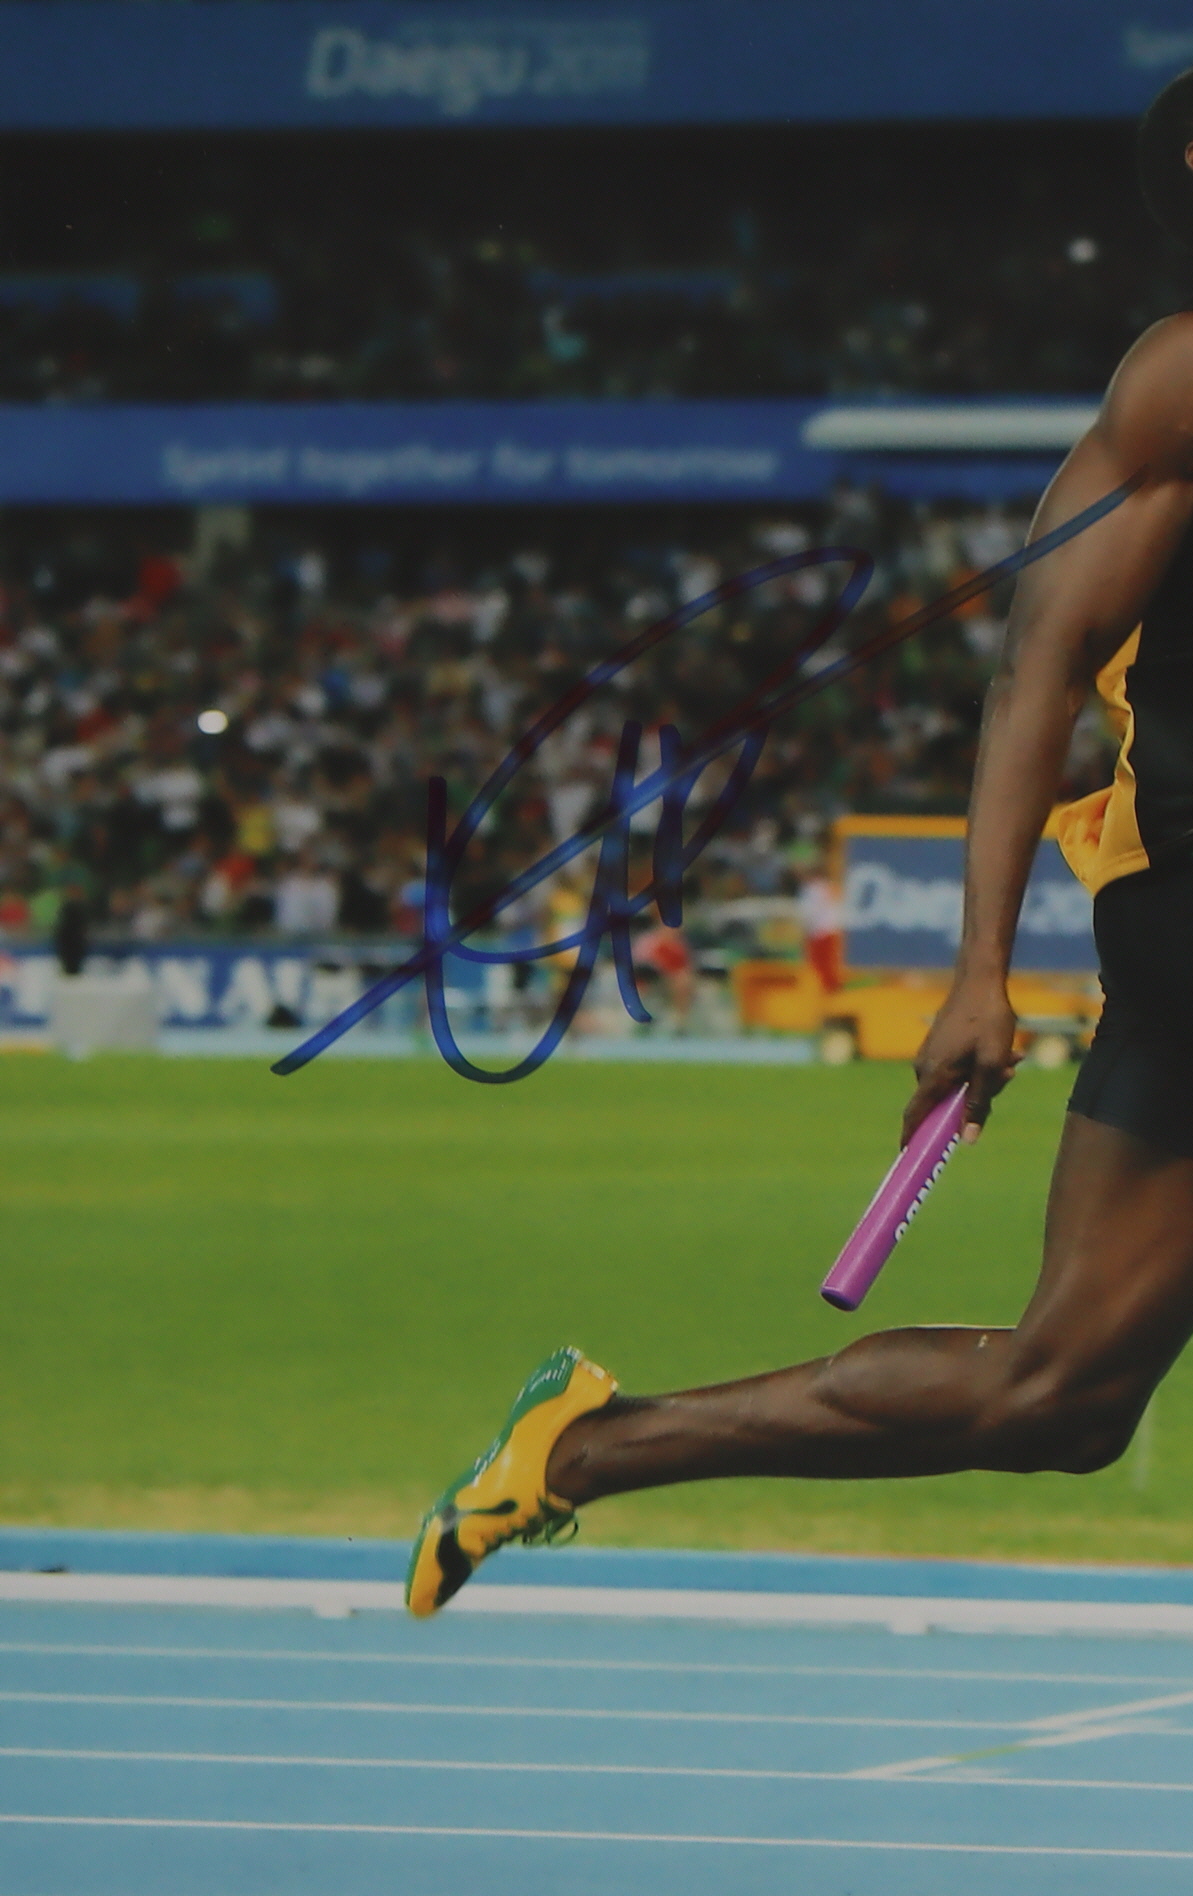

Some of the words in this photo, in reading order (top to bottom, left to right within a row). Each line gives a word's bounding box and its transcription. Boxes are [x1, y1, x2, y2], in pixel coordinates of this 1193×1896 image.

[307, 27, 528, 117] Daegu
[299, 443, 481, 498] together
[493, 439, 555, 482] for
[564, 444, 778, 484] tomorrow
